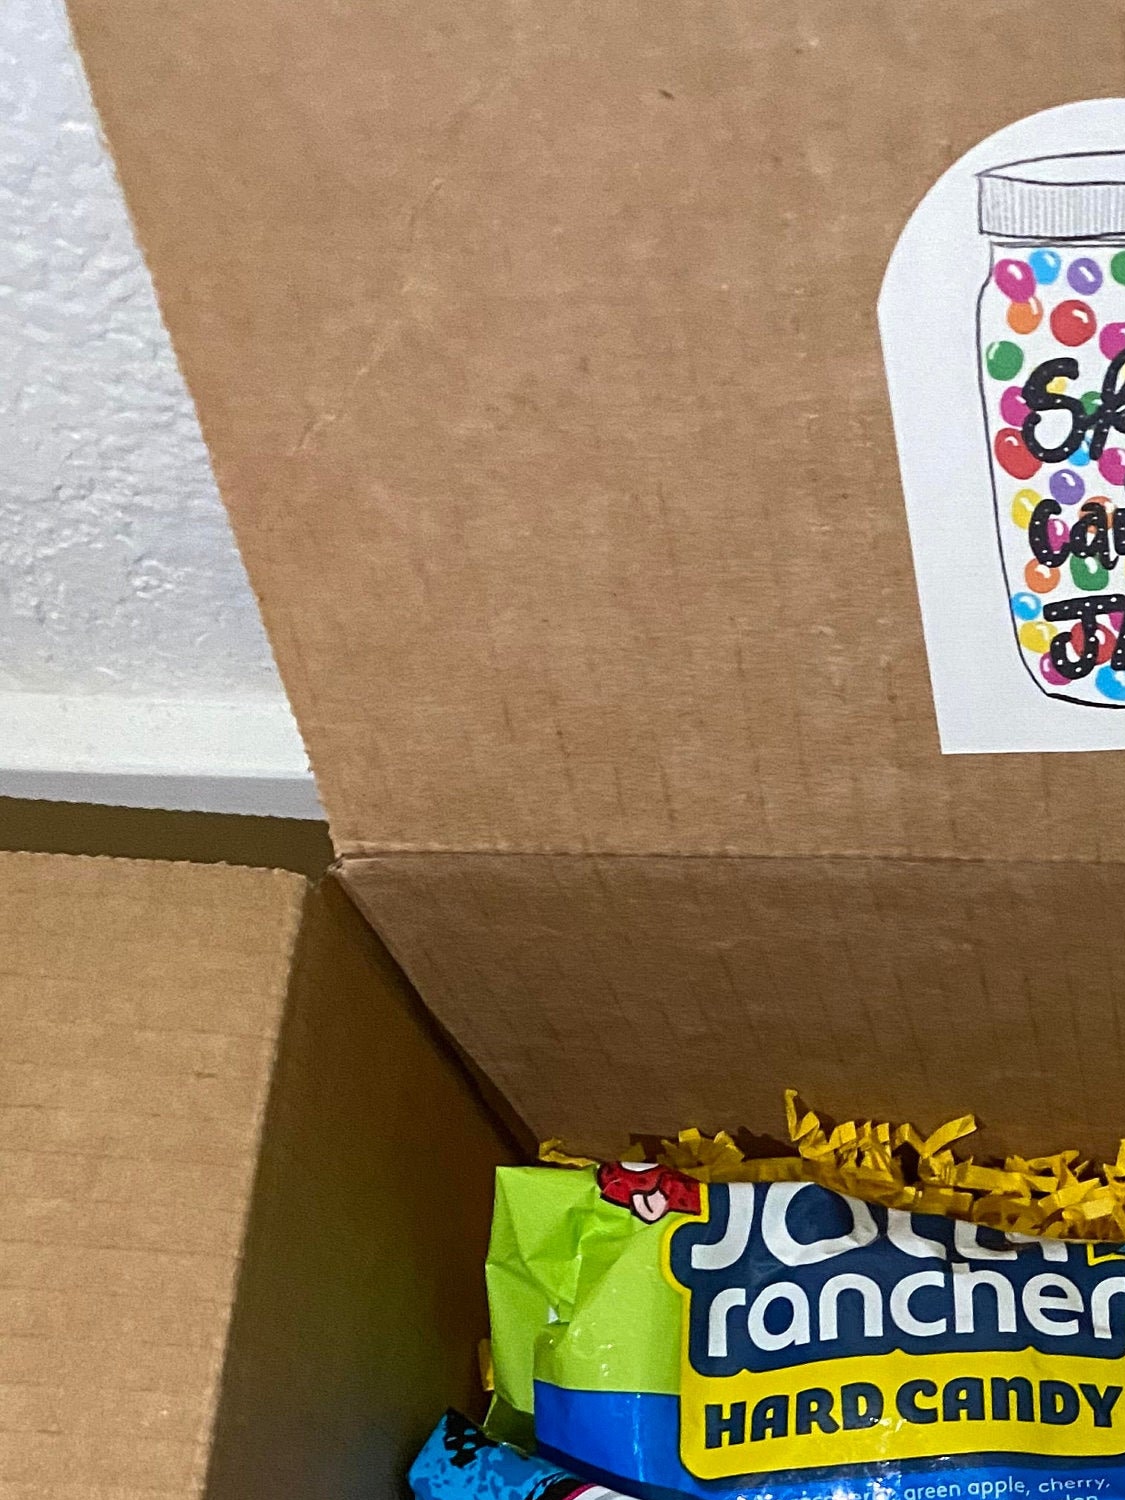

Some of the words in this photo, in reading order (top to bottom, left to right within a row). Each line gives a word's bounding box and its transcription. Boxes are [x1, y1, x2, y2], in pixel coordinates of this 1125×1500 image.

[703, 1386, 884, 1449] HARD
[895, 1376, 1123, 1429] CANDY
[967, 1476, 1030, 1499] apple,
[1038, 1477, 1110, 1494] cherry,
